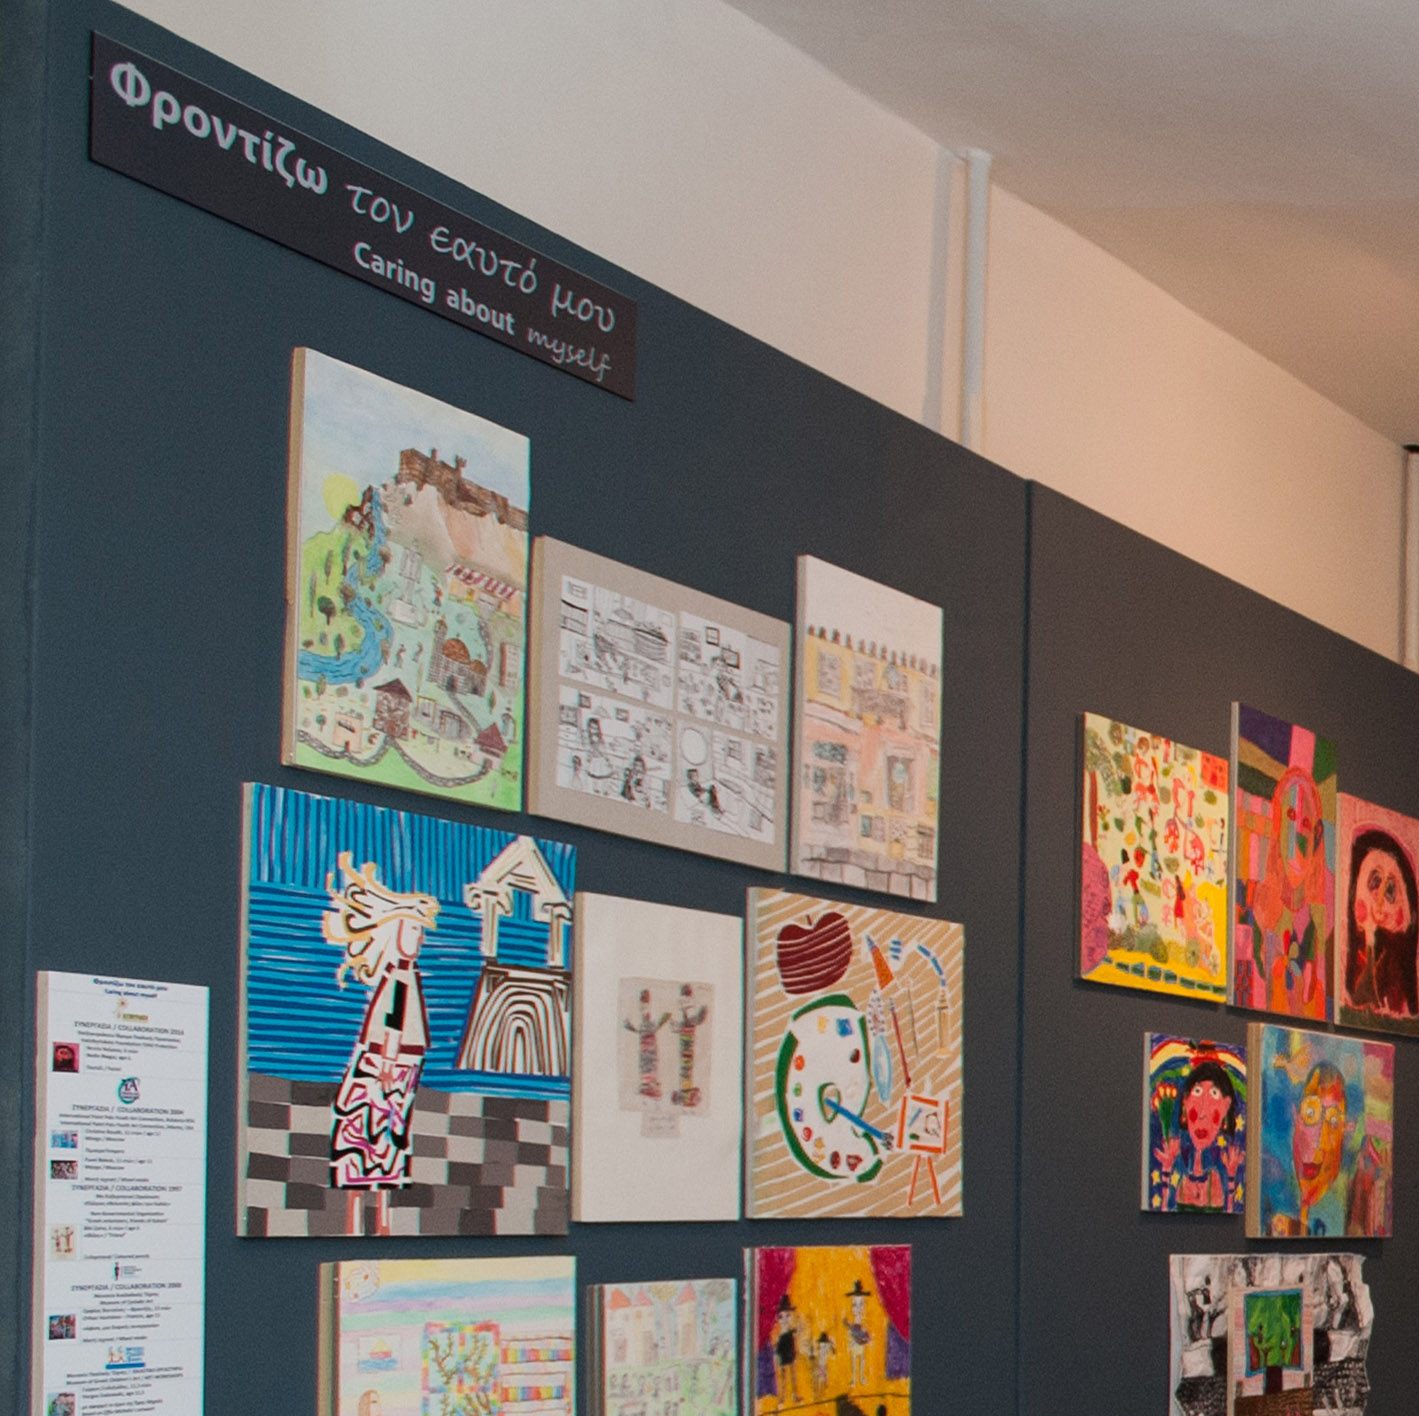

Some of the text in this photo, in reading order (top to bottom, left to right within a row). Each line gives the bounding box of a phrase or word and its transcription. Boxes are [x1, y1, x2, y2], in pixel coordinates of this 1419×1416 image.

[109, 61, 616, 334] Φροντίζω τον εαυτό μου
[353, 241, 612, 384] Caring about myself
